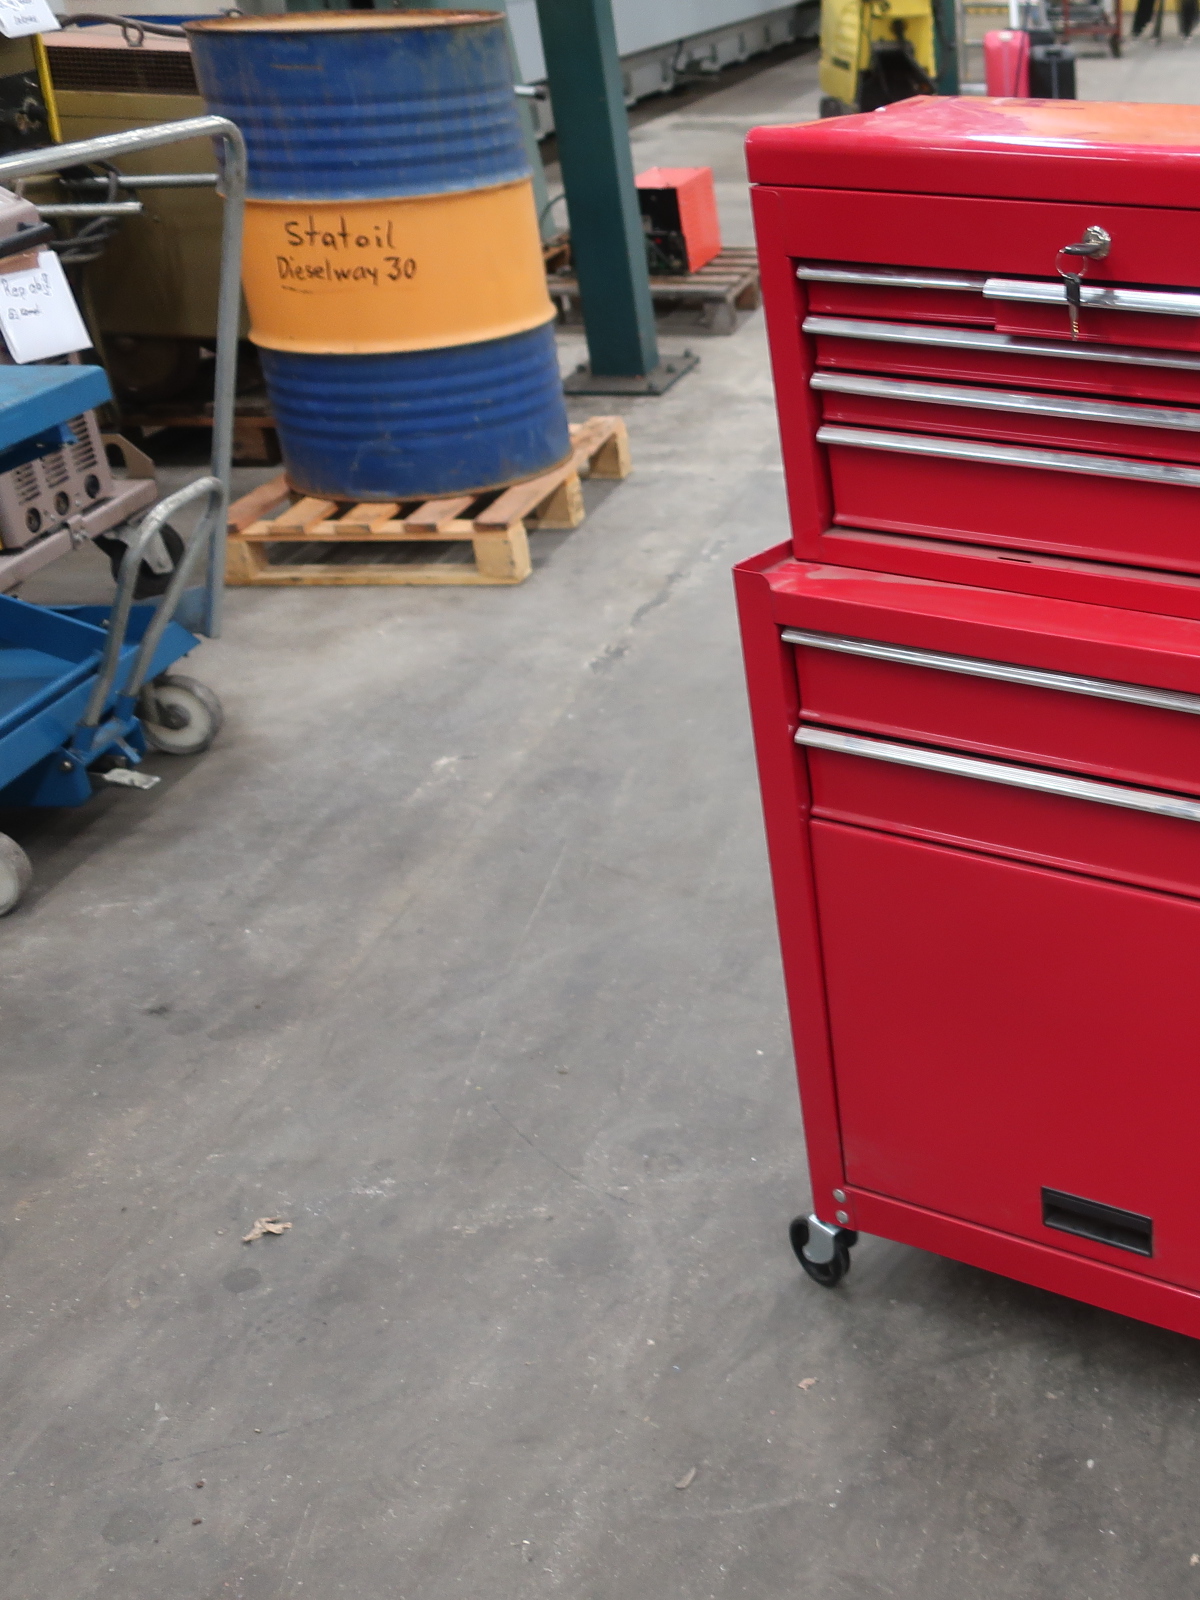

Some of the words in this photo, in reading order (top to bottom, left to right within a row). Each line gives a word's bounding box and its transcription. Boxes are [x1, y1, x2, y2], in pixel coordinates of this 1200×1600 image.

[284, 214, 396, 250] Statoil
[276, 254, 379, 286] Dieselway
[383, 255, 417, 281] 30
